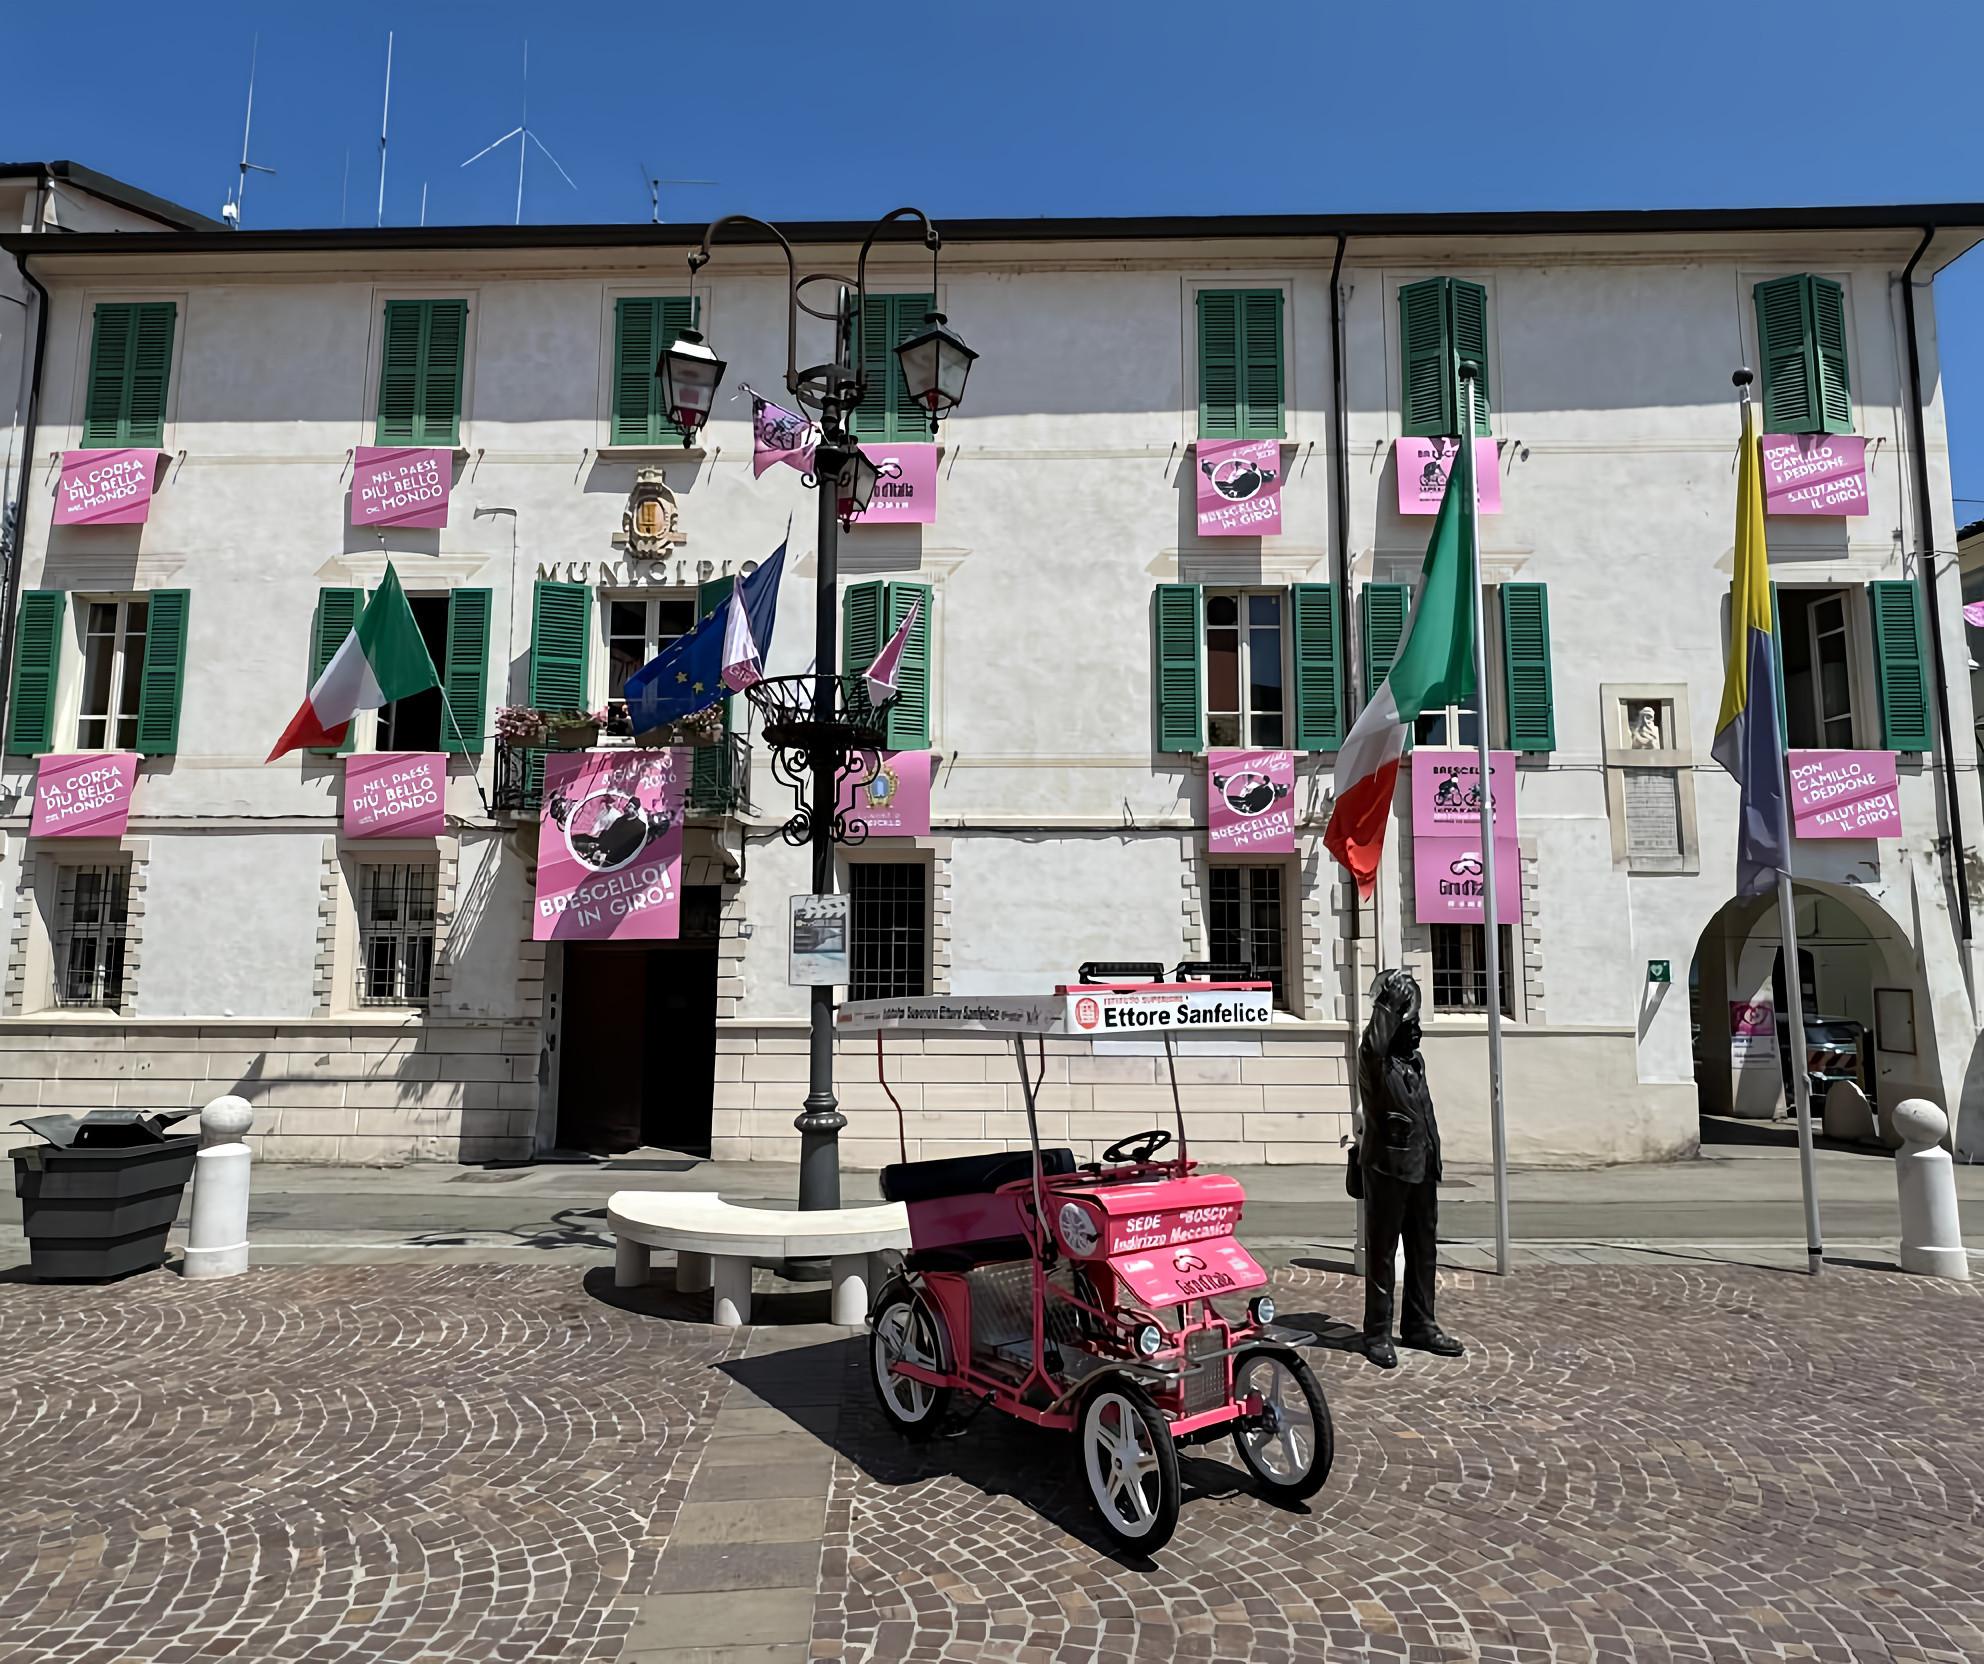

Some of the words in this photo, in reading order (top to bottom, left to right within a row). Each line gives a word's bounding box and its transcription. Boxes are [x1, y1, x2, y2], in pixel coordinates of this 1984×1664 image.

[64, 476, 84, 491] LA
[394, 472, 439, 492] BELLO
[84, 484, 137, 508] MONDO
[382, 484, 442, 511] MONDO
[536, 559, 759, 587] MUNICIPIO
[40, 784, 61, 799] LA
[66, 766, 122, 790] CORSA
[363, 778, 388, 793] NEL
[392, 763, 431, 785] PAESE
[1433, 766, 1495, 775] BRESCELO
[1791, 762, 1823, 779] DON
[1797, 763, 1861, 791] CAMILLO
[78, 778, 124, 801] BELLA
[386, 777, 433, 801] BELLO
[60, 793, 115, 818] MONDO
[373, 791, 437, 820] MONDO
[1816, 798, 1885, 825] SALUTANO
[1840, 820, 1855, 832] IL
[1233, 835, 1249, 847] IN
[540, 868, 659, 918] BRESCELLO
[577, 906, 602, 928] IN
[1104, 1006, 1171, 1028] Ettore
[1177, 1003, 1268, 1025] Sanfelice
[1126, 1215, 1162, 1233] SEDE
[1114, 1233, 1167, 1252] Indirizzo
[1170, 1222, 1233, 1243] Meccanico
